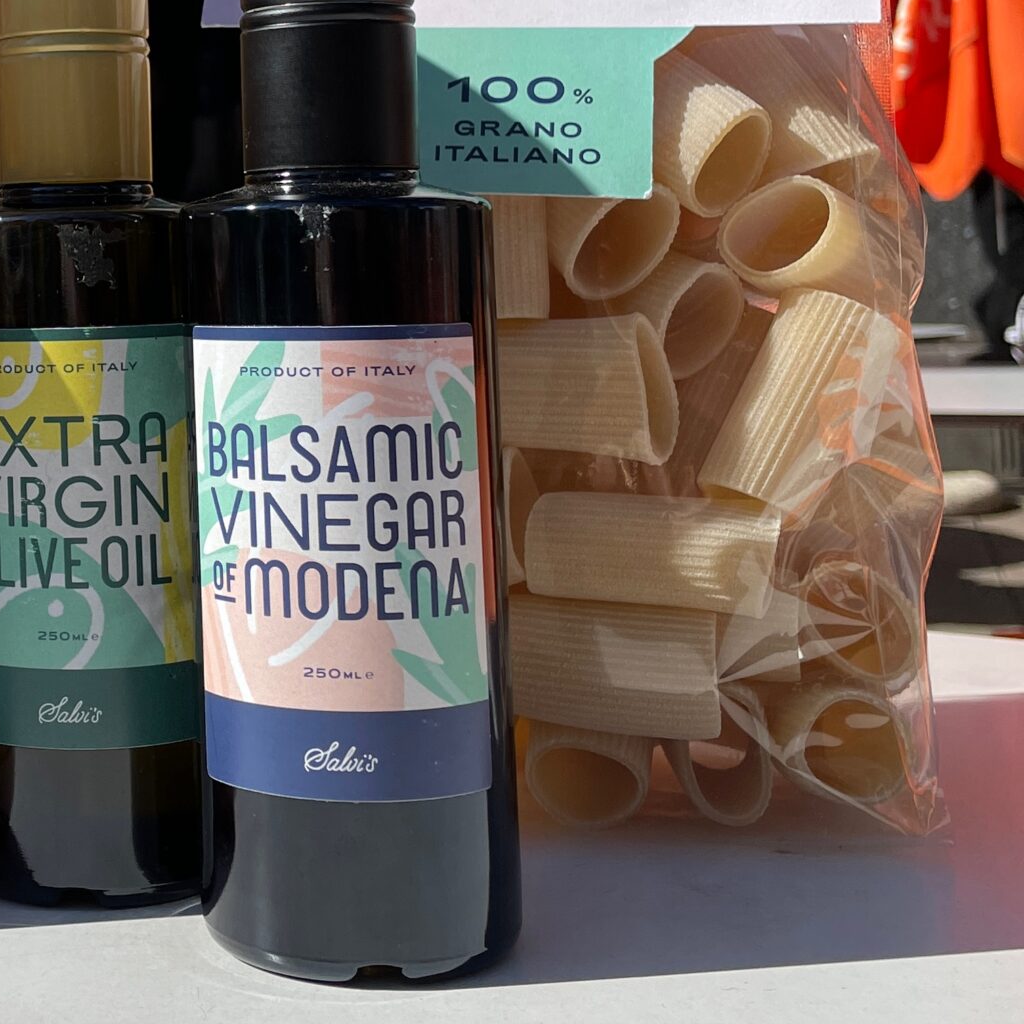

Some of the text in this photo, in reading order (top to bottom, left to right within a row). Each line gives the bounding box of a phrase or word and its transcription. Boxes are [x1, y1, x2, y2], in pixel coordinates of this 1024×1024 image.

[447, 75, 593, 105] 100%
[454, 120, 582, 138] GRANO
[434, 145, 601, 165] ITALIANO
[63, 362, 85, 374] OF
[92, 361, 138, 373] ITALY
[239, 364, 417, 378] PRODUCT OF ITALY
[208, 420, 463, 484] BALSAMIC
[210, 487, 467, 552] VINEGAR
[101, 533, 173, 588] OIL
[213, 560, 237, 594] OF
[244, 557, 470, 622] MODENA
[38, 696, 103, 725] Salvi's
[303, 741, 378, 775] Salvi's
